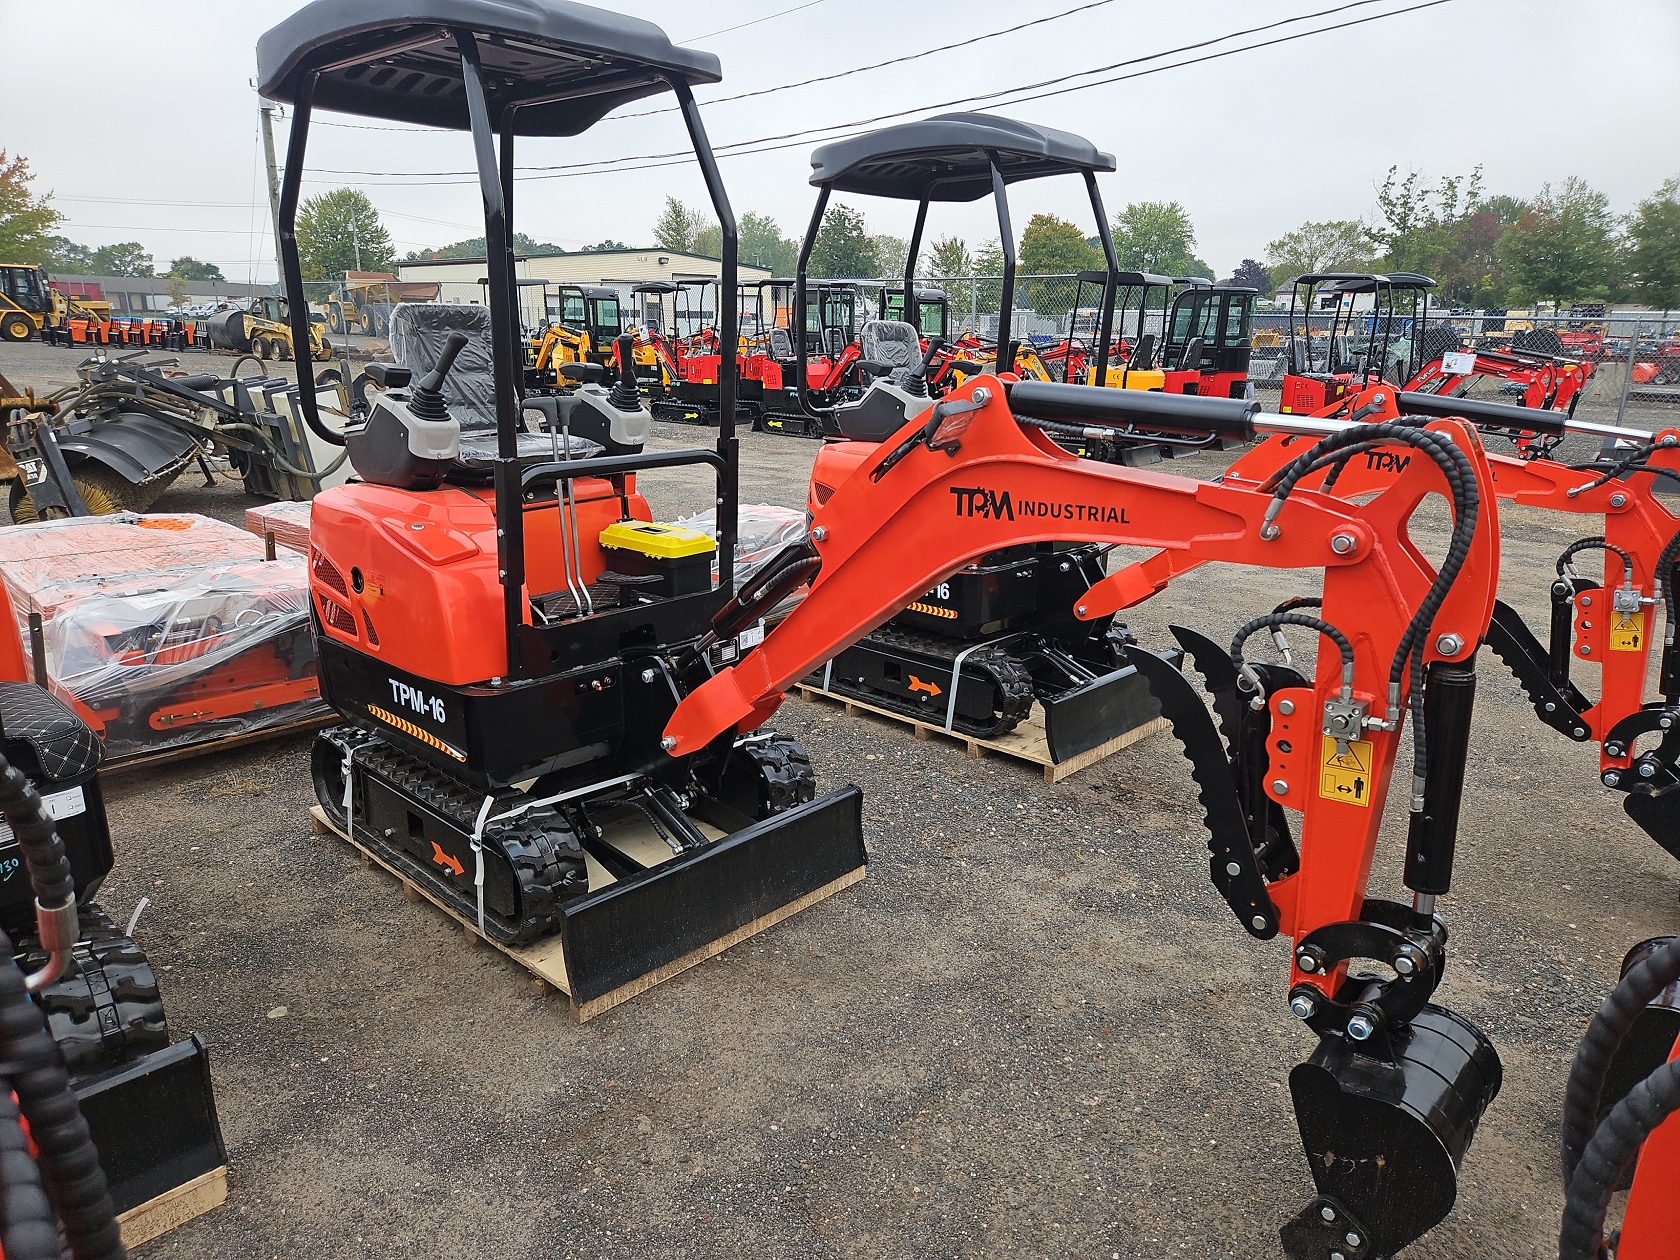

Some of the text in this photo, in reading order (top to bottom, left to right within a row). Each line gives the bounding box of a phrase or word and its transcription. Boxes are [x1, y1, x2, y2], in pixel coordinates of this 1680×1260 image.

[949, 486, 1131, 524] TPM INDUSTRIAL
[388, 678, 446, 723] TPM-16
